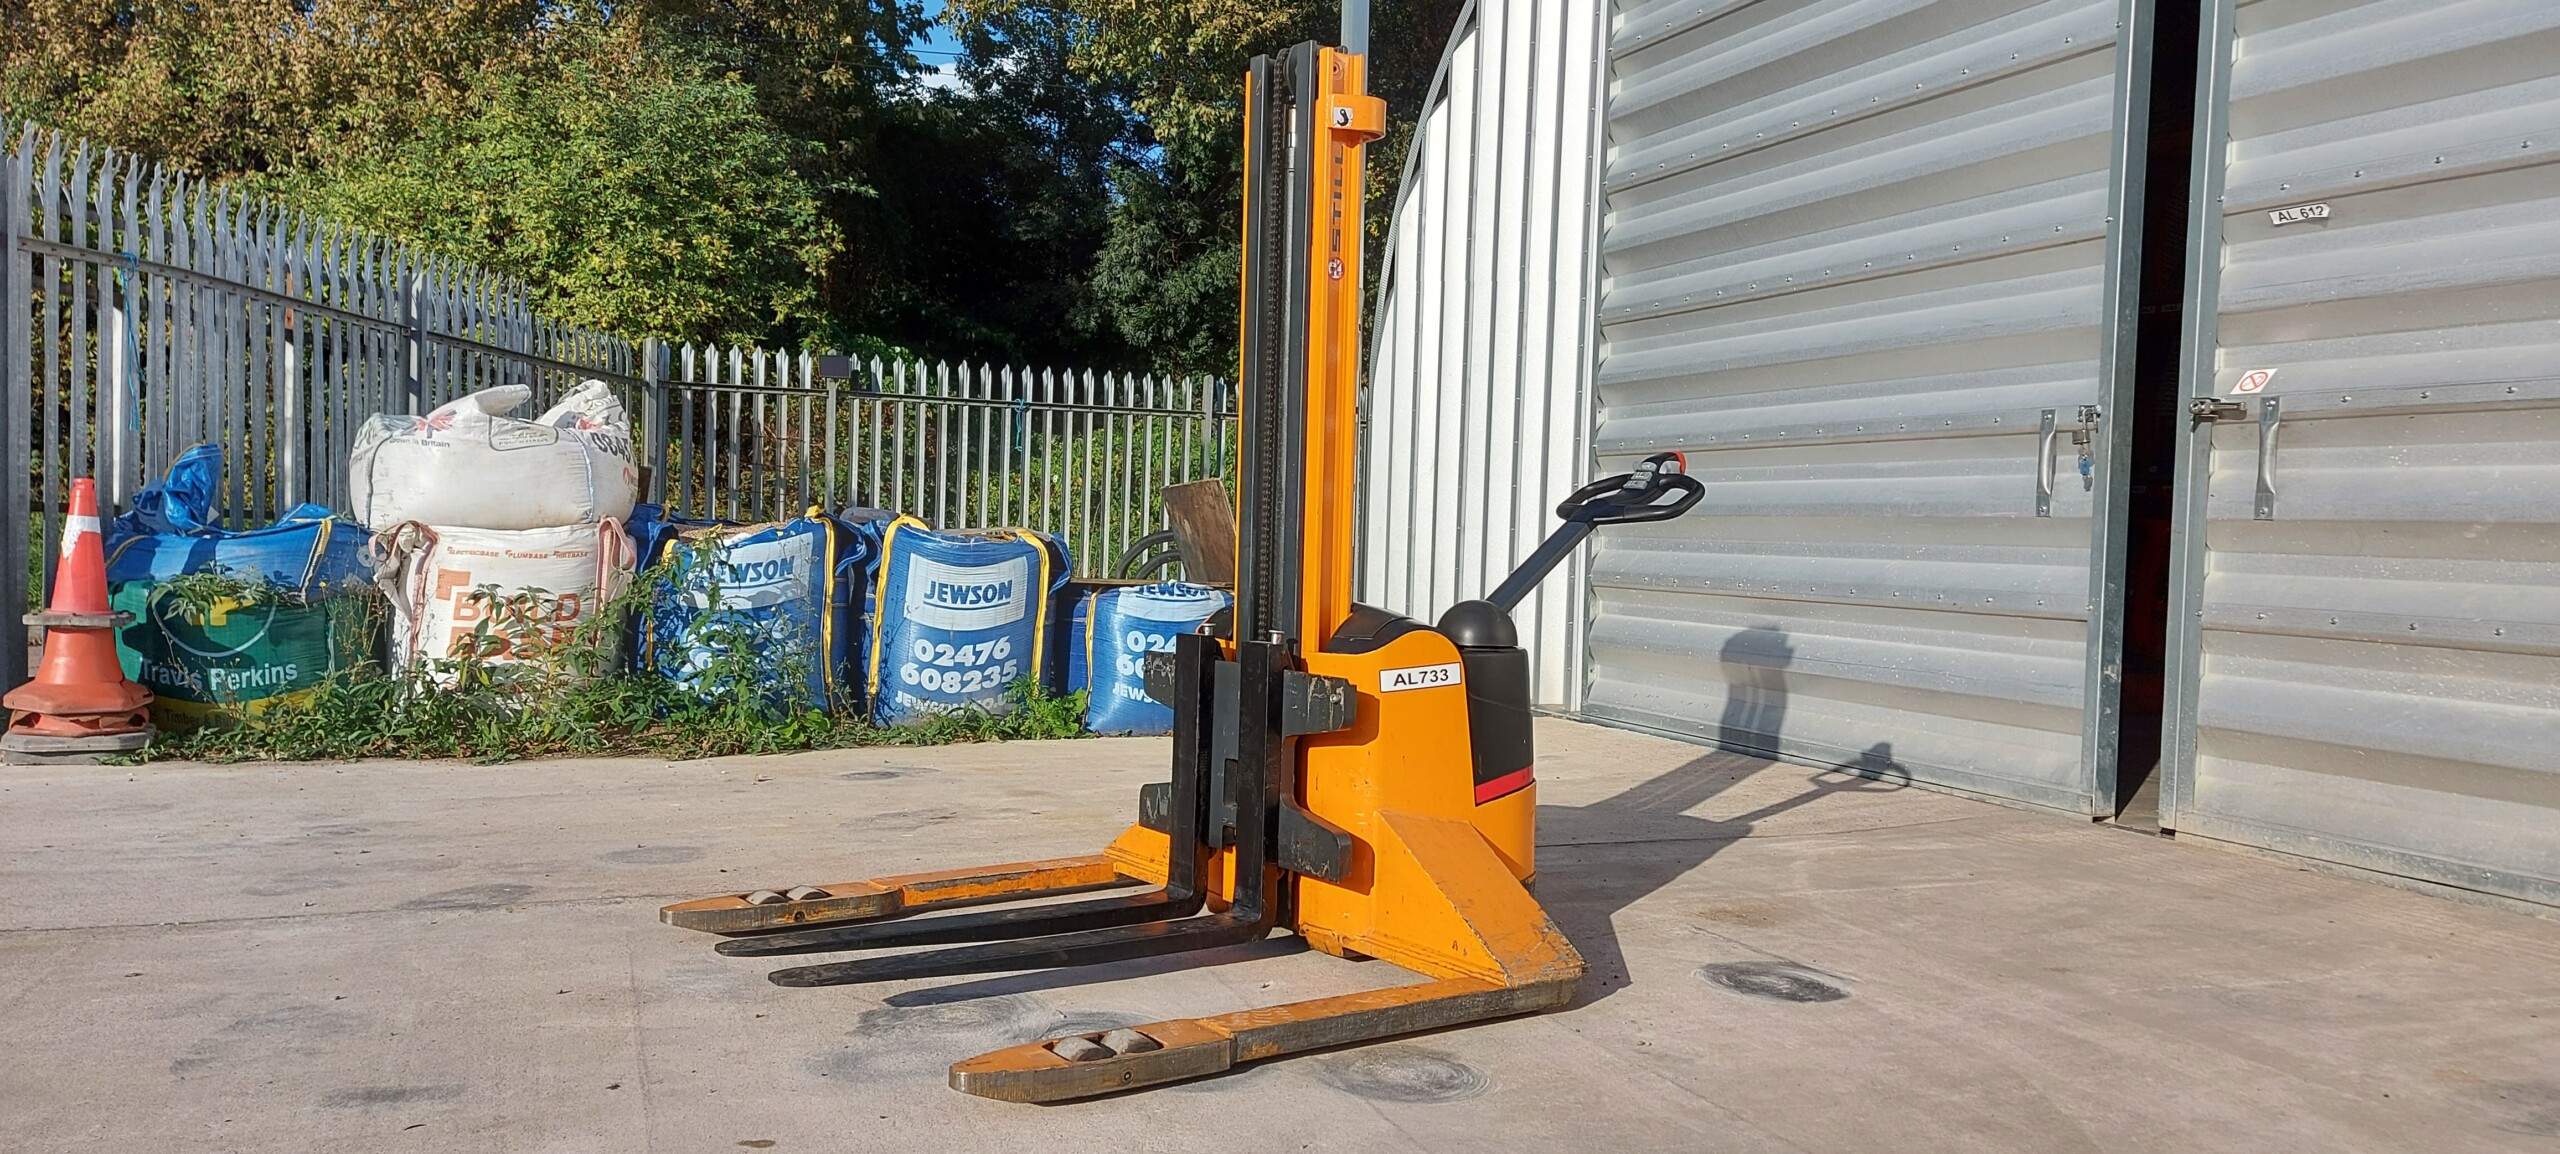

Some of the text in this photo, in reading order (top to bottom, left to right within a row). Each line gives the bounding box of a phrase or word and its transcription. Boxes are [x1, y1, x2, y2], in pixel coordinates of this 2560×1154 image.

[1332, 145, 1344, 252] STILL
[2278, 210, 2298, 222] AL
[421, 439, 451, 449] Britain
[507, 551, 549, 560] PLUMBASE
[702, 555, 795, 584] EWSON
[924, 579, 1013, 605] JEWSON
[913, 635, 1011, 667] 02476
[1126, 630, 1178, 655] 024
[142, 658, 299, 691] Travis Perkins
[900, 658, 1018, 694] 608235
[165, 708, 199, 729] Timber
